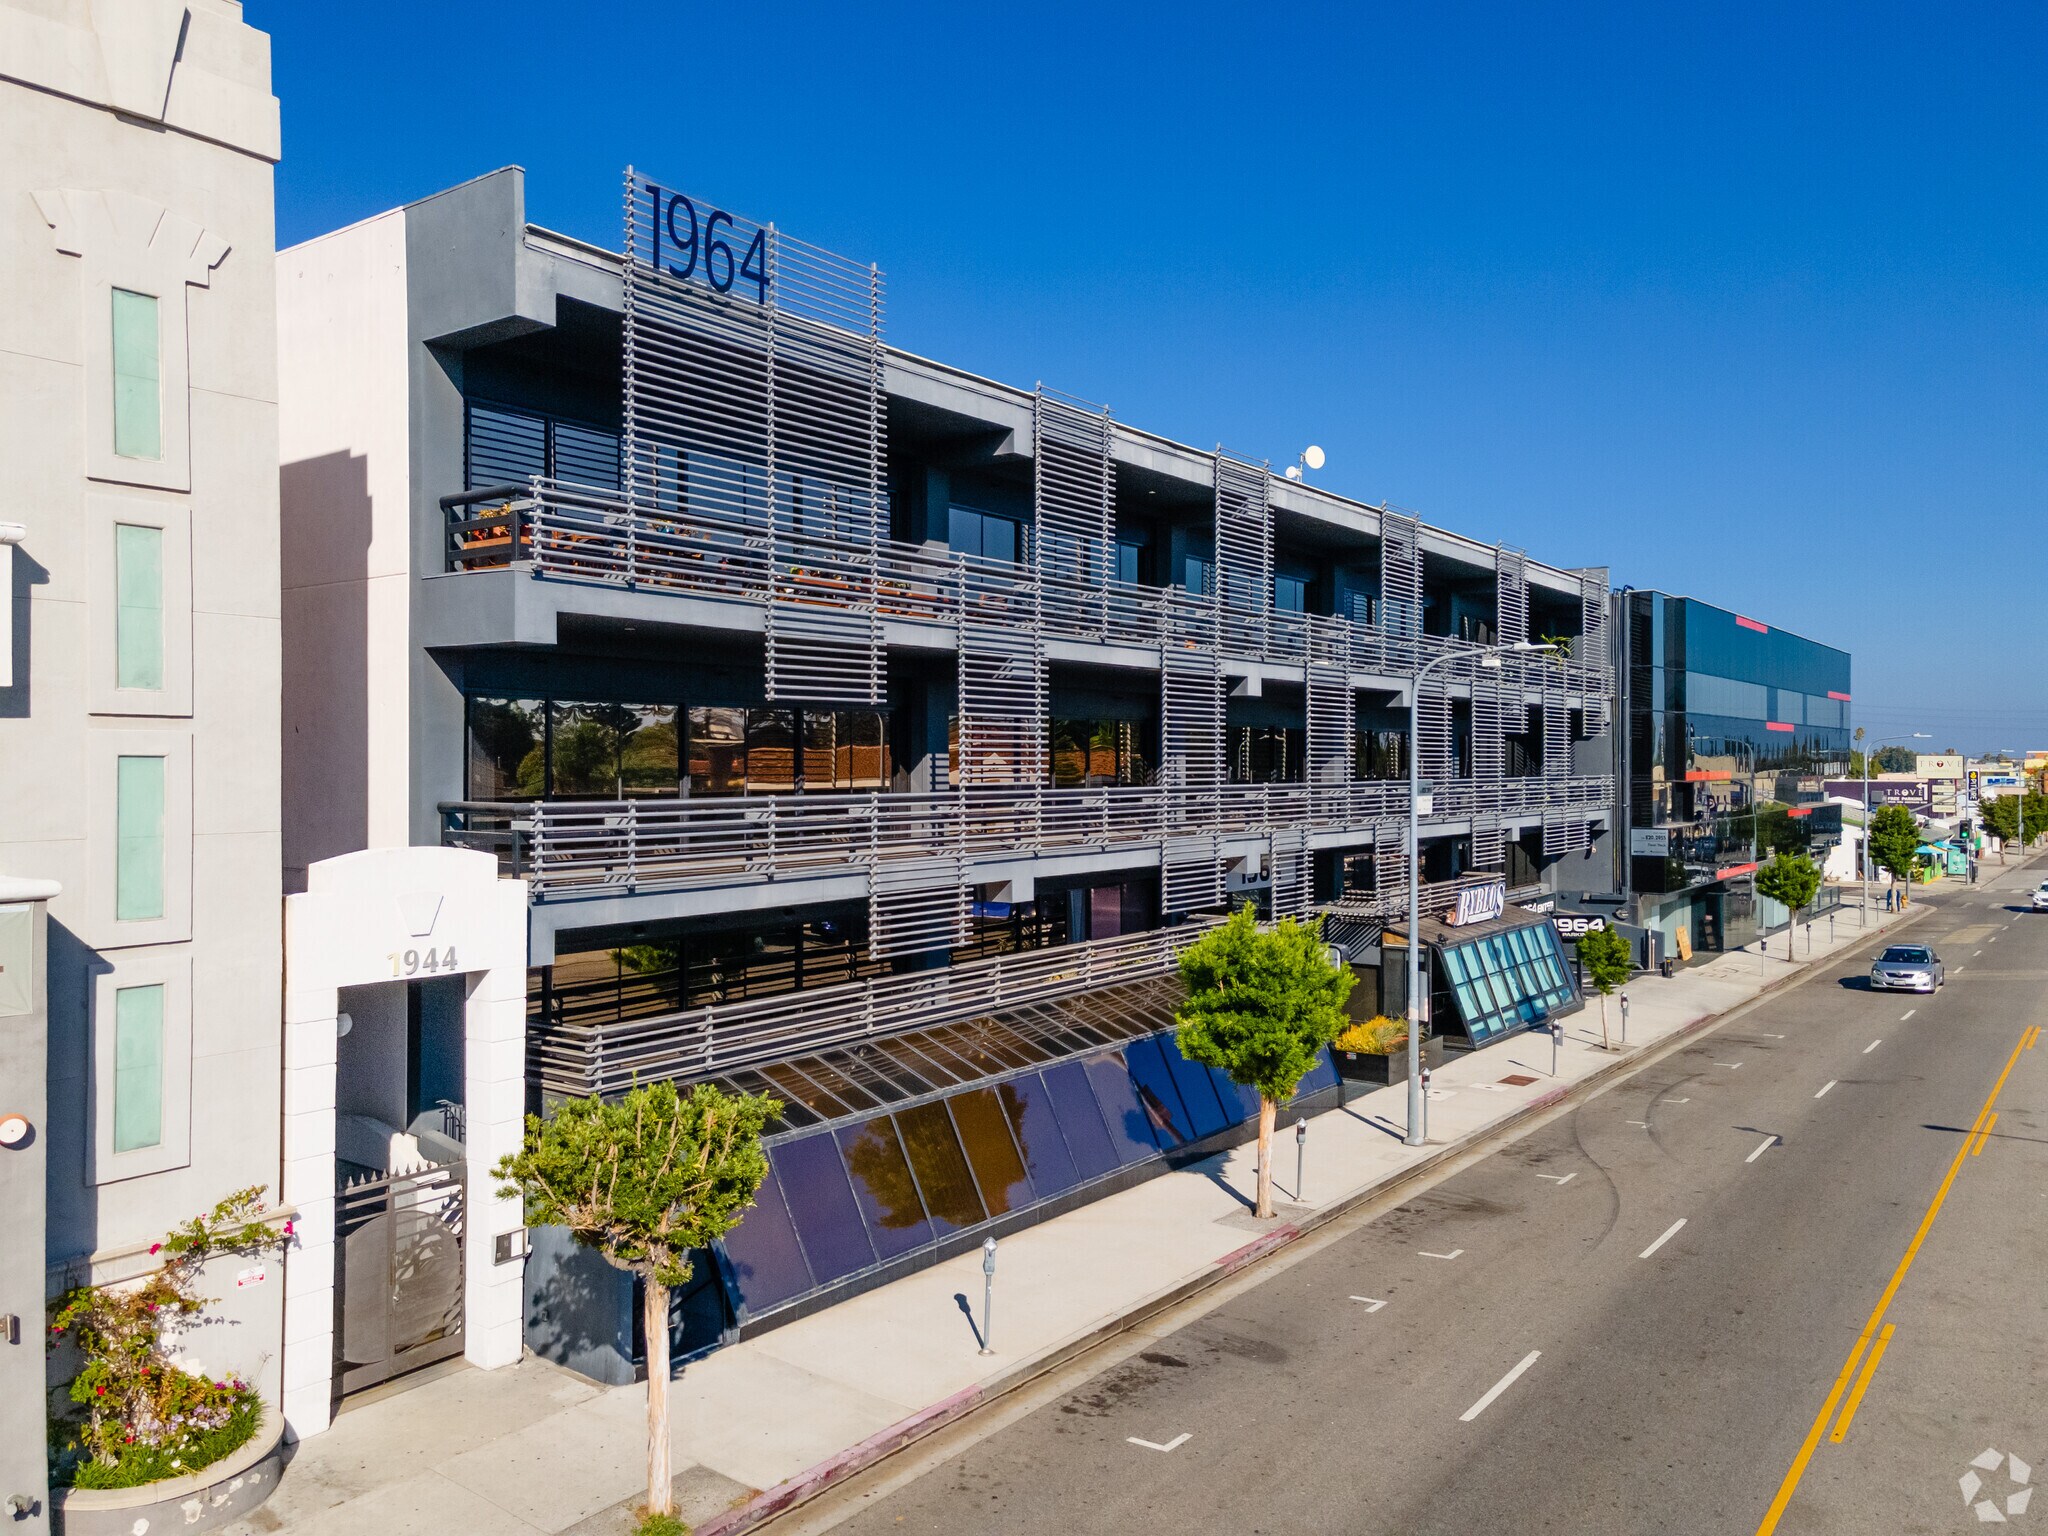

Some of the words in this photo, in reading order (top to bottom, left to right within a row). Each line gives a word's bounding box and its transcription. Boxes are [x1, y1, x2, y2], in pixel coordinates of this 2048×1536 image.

[645, 184, 770, 305] 1964
[1456, 883, 1505, 926] BYBLOS
[387, 946, 458, 977] 1944
